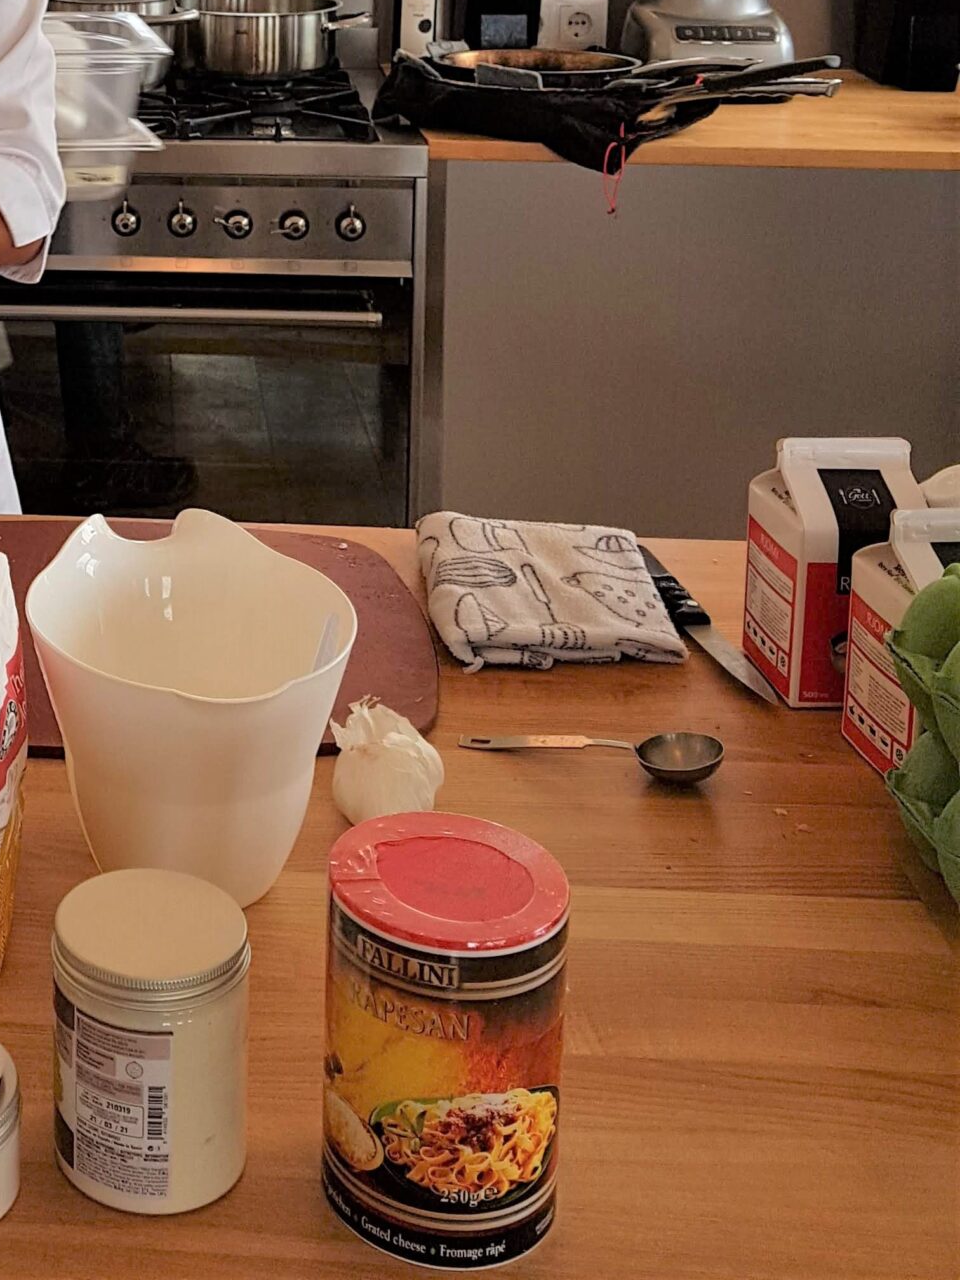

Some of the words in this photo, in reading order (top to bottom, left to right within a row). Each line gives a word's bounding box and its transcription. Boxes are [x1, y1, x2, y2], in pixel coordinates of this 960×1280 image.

[361, 938, 456, 987] FALLINI
[106, 1101, 131, 1114] 210319
[440, 1189, 479, 1208] 250g
[361, 1216, 391, 1243] Grated
[393, 1233, 427, 1254] cheese
[439, 1243, 484, 1260] Fromage
[486, 1239, 507, 1257] râpé
